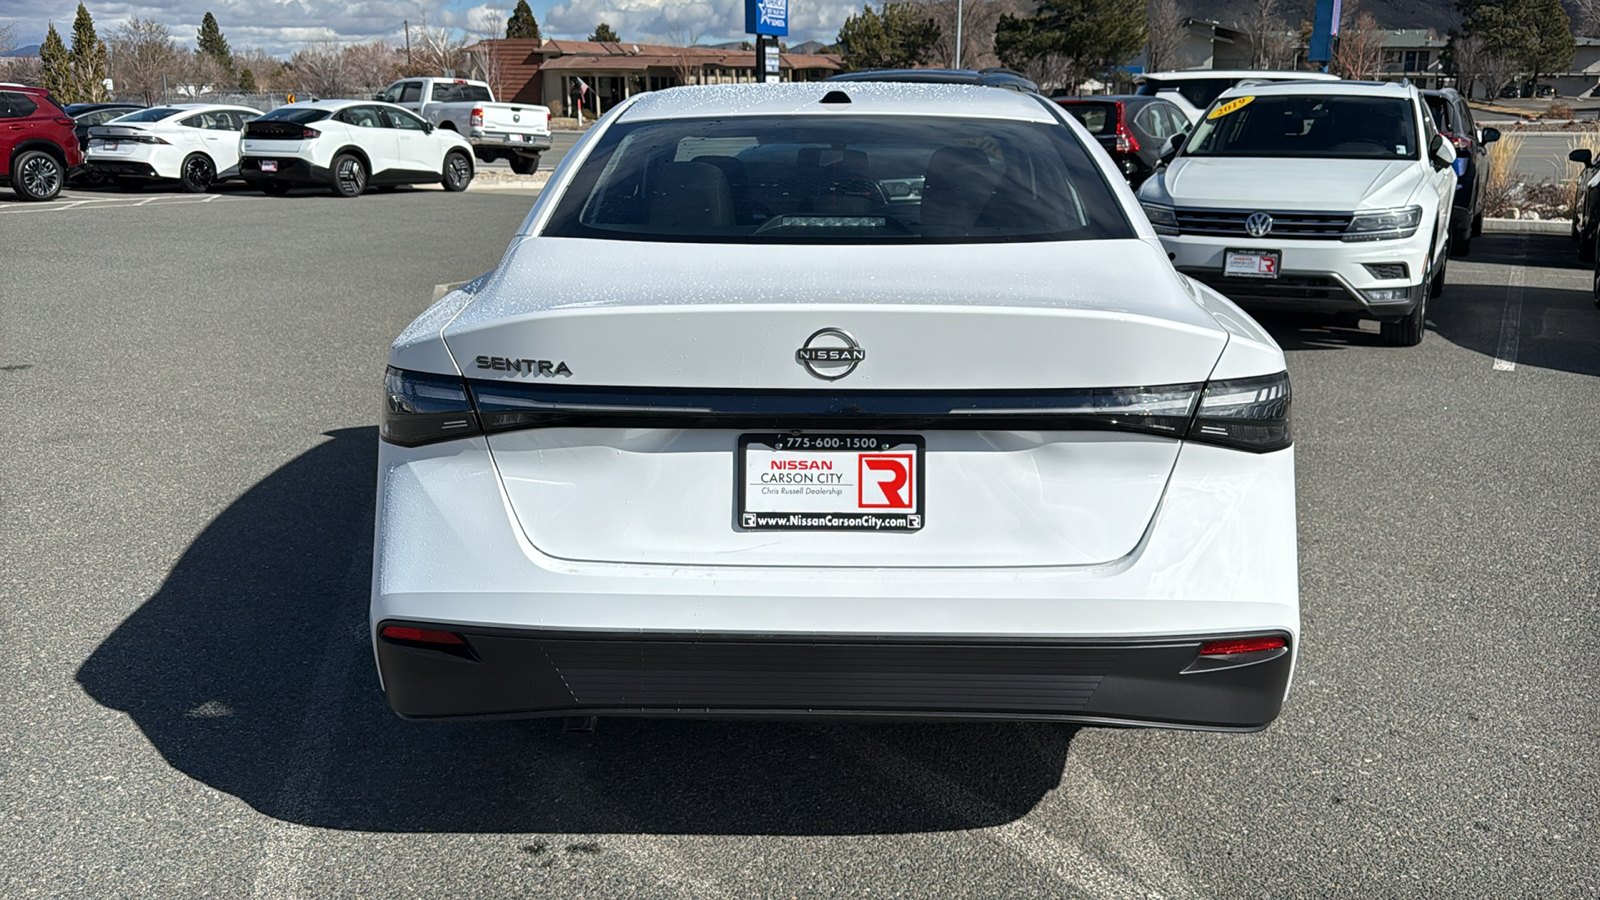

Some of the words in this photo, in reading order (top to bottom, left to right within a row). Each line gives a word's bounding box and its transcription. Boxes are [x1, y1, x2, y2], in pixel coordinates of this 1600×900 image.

[1217, 98, 1246, 116] 2019
[799, 350, 863, 360] NISSAN
[476, 355, 573, 375] SENTRA
[787, 437, 877, 448] 775-600-1500
[771, 460, 832, 470] NISSAN
[760, 472, 813, 484] CARSON
[817, 473, 843, 484] CITY
[761, 487, 779, 495] Chris
[781, 487, 804, 495] Russell
[805, 487, 843, 496] Dealership
[757, 514, 906, 530] www.NissanCarsonCity.com
